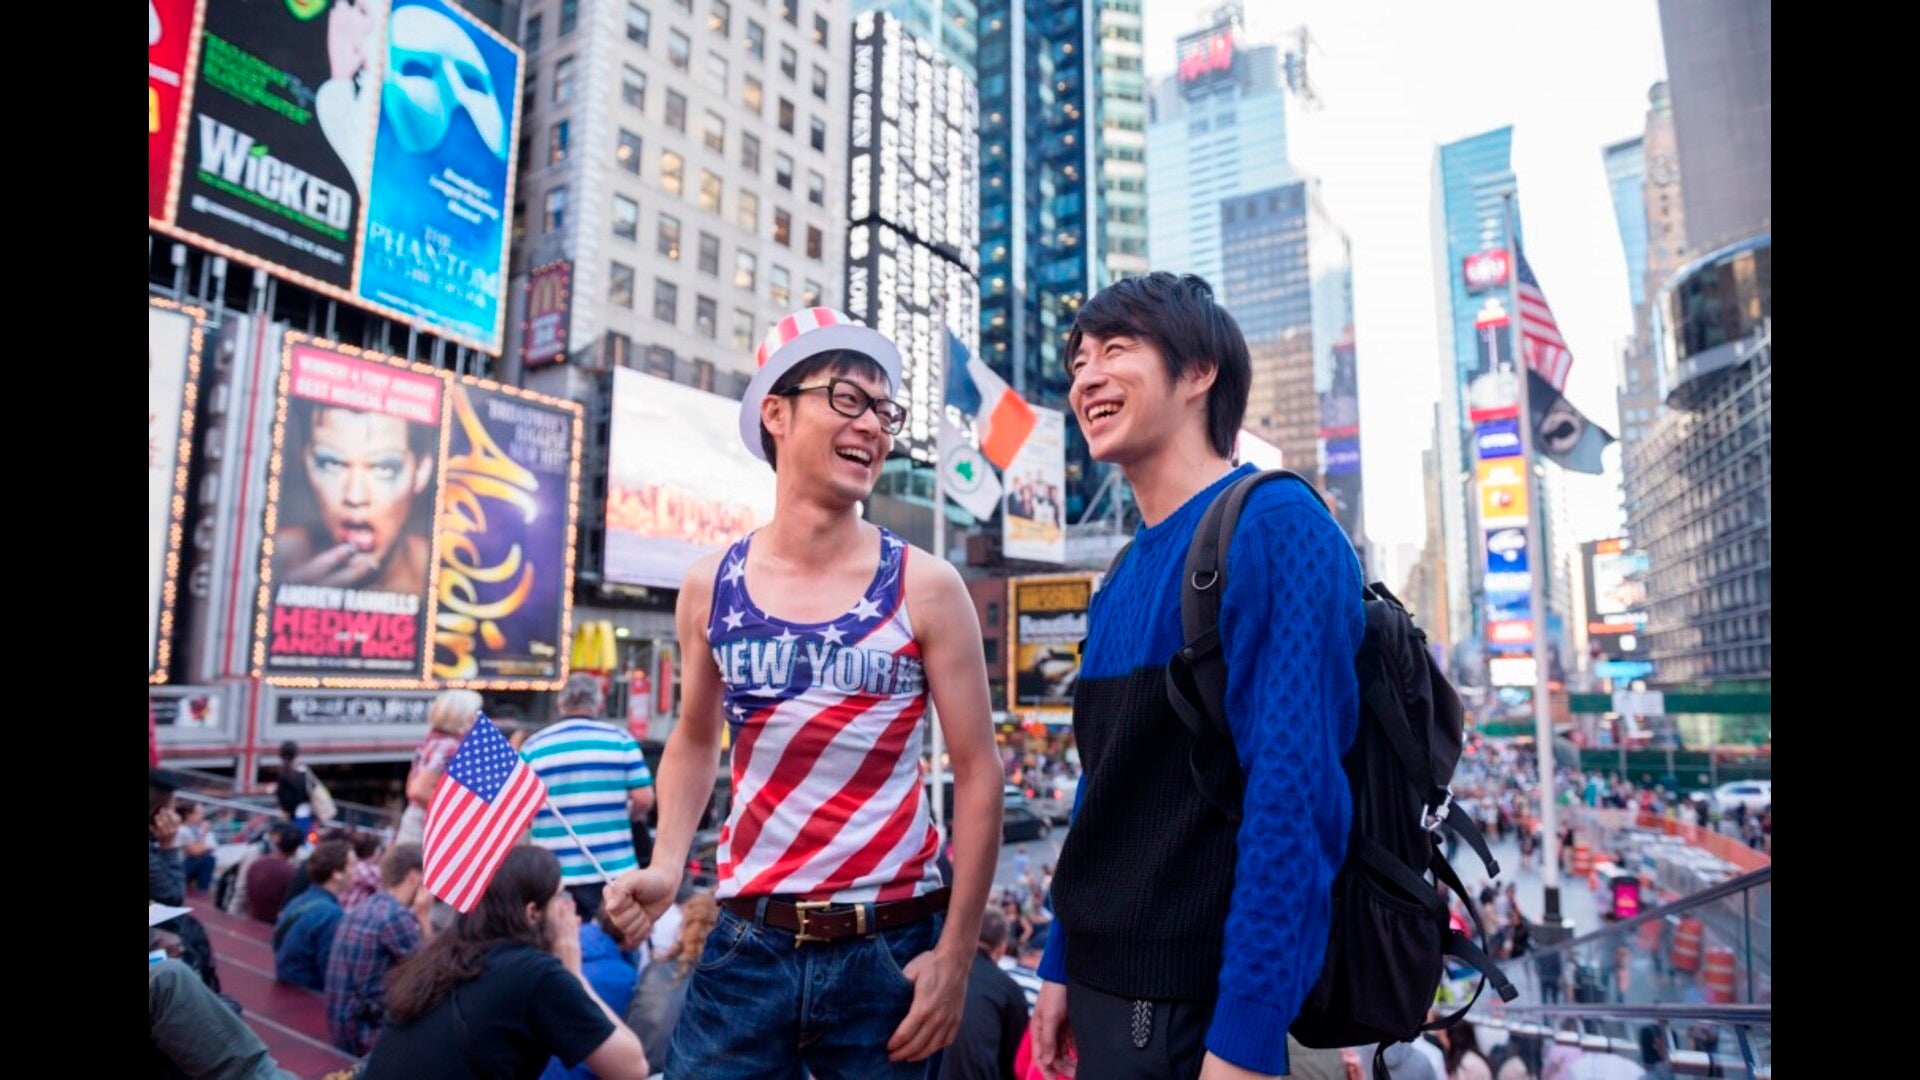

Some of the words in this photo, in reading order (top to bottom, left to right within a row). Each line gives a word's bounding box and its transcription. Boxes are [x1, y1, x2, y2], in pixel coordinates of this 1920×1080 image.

[272, 605, 417, 643] HEDWIG
[270, 635, 356, 657] ANGRY
[711, 637, 797, 688] NEW
